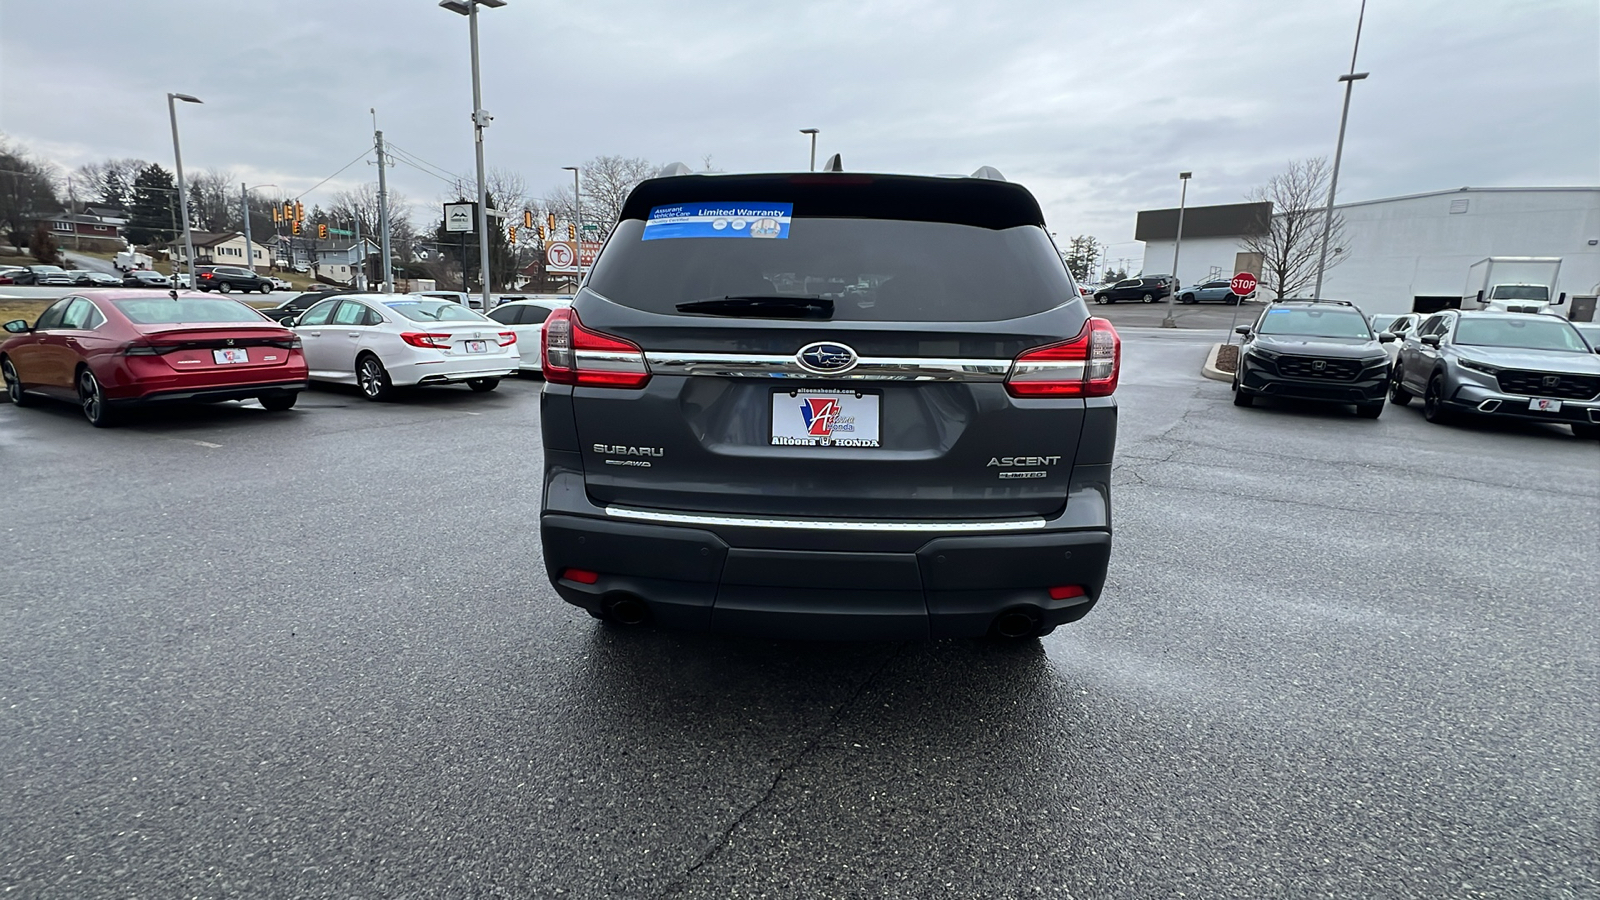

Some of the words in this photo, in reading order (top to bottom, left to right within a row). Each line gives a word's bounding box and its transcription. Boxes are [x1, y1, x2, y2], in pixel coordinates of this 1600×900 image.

[698, 208, 736, 216] Limited
[737, 209, 784, 217] Warranty
[1232, 279, 1256, 289] STOP
[772, 436, 816, 446] Altoona
[835, 439, 879, 447] HONDA
[593, 443, 664, 457] SUBARU
[986, 456, 1061, 467] ASCENT
